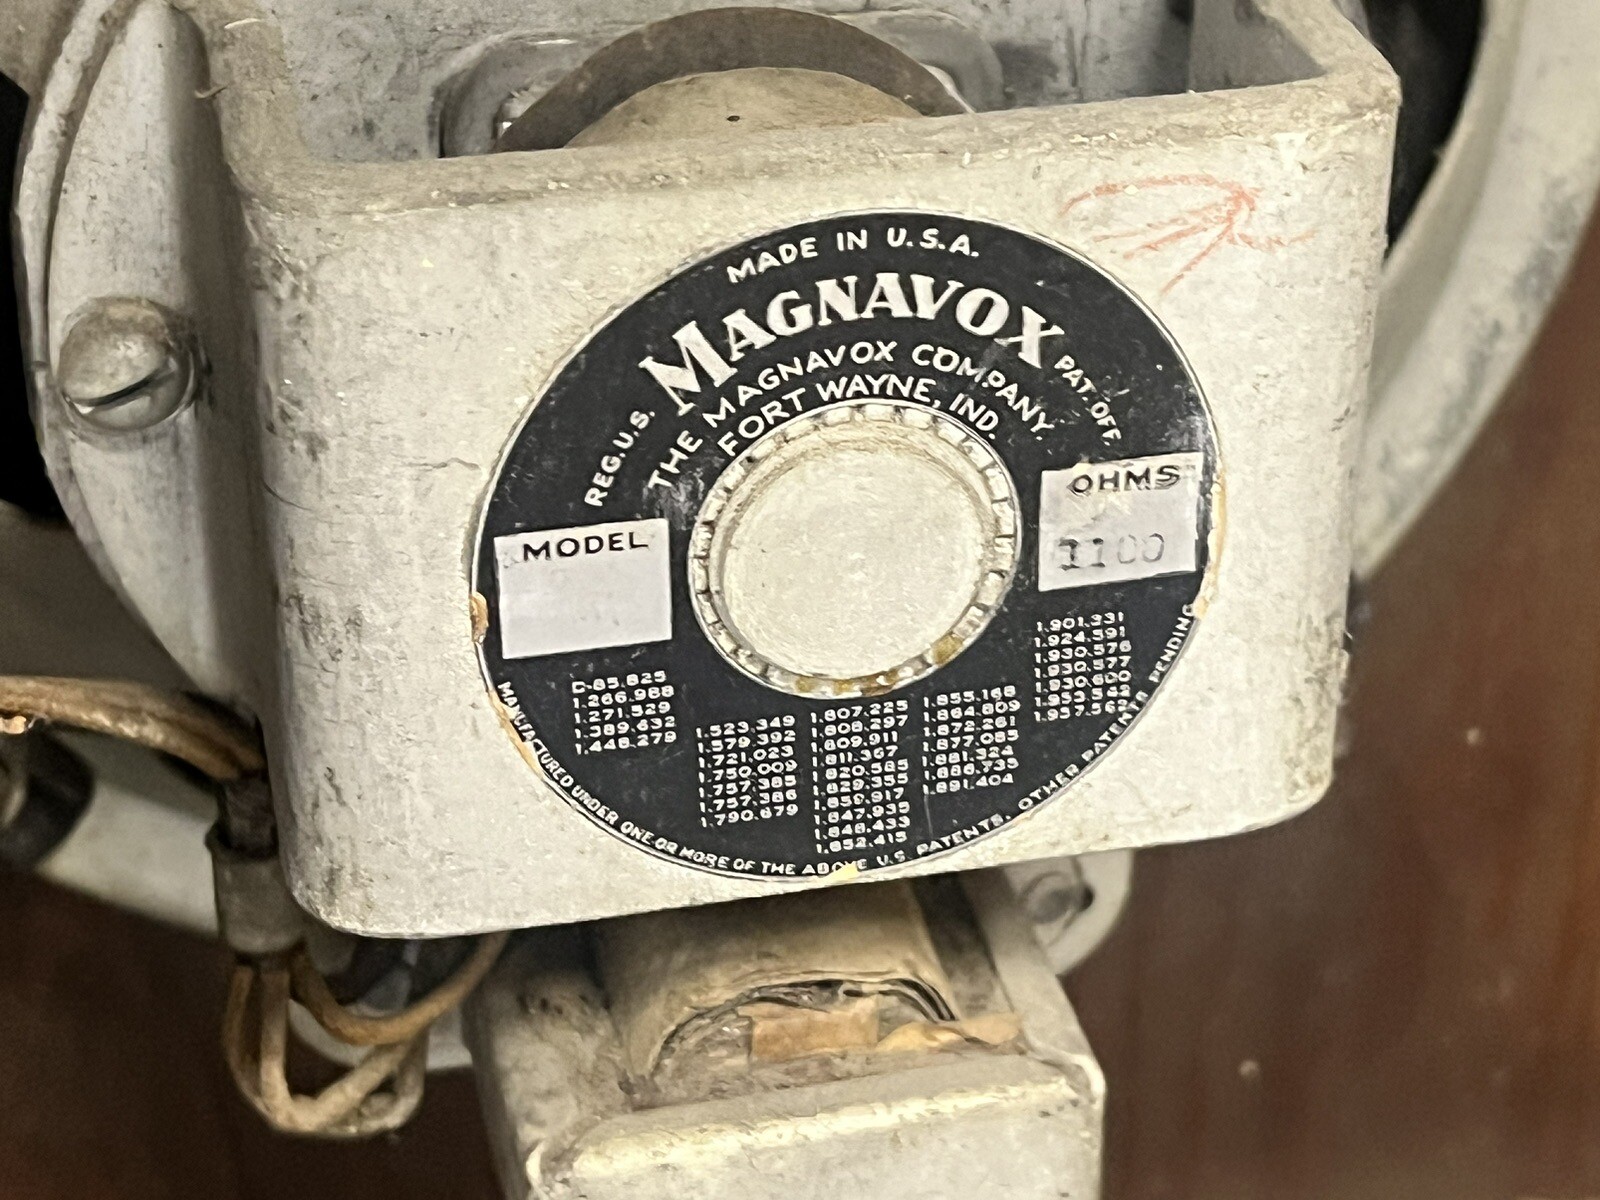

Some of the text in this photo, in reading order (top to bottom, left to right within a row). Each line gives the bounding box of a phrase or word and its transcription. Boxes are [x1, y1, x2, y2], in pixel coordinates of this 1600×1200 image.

[727, 227, 980, 284] MADE IN U.S.A.
[638, 272, 1065, 416] MAGNAVOX
[648, 430, 703, 489] THE
[702, 340, 898, 428] MAGNAVOX
[717, 374, 1000, 457] FORT WAYNE, IND.
[1066, 464, 1181, 496] OHMS
[523, 531, 650, 562] MODEL
[1058, 533, 1165, 570] 1100
[571, 785, 619, 825] UNDER
[620, 821, 655, 845] ONE
[654, 838, 679, 855] OR
[679, 846, 730, 869] MORE
[732, 858, 756, 872] OF
[761, 861, 796, 875] THE
[801, 858, 867, 875] ABOE
[1018, 763, 1079, 810] OTHER
[1149, 604, 1194, 683] PENDING
